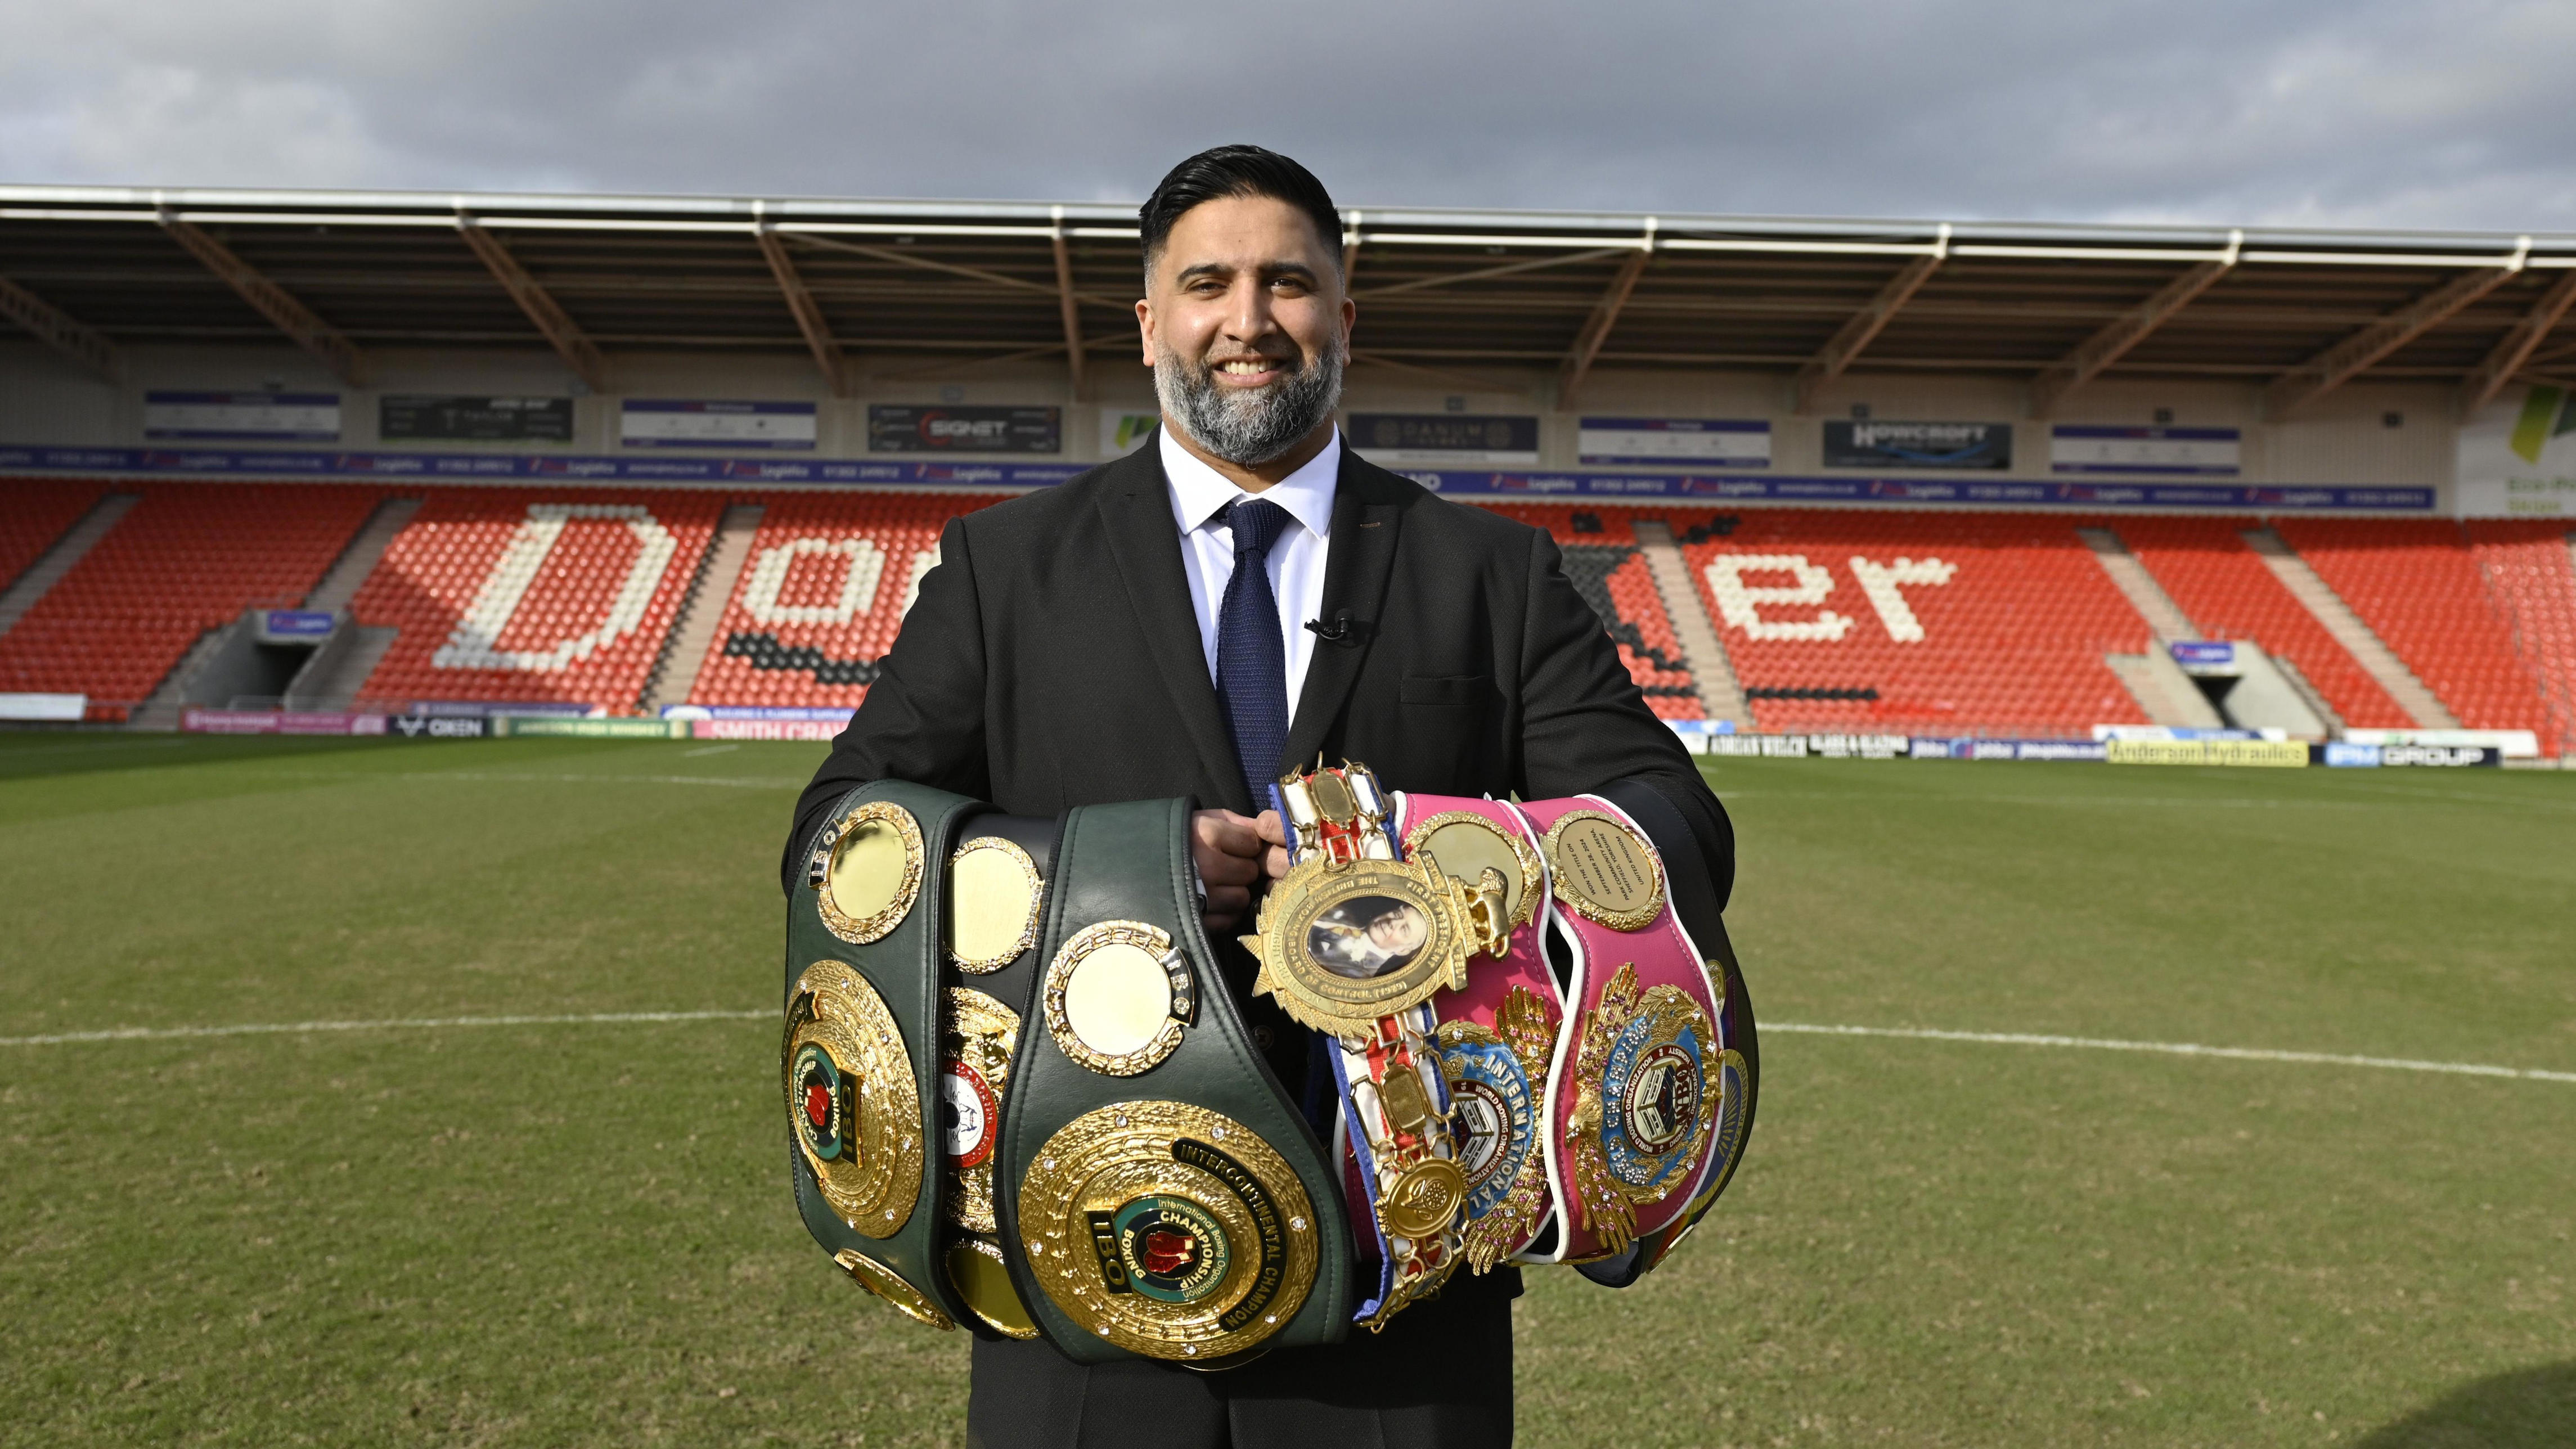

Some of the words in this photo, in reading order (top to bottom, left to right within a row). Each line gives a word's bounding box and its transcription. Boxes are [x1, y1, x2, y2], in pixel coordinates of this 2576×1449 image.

[929, 420, 1008, 436] SIGNET
[1853, 424, 1989, 448] HOWCROFT
[428, 719, 483, 737] OXEN
[712, 722, 781, 740] SMITH
[1859, 735, 1909, 753] GLAZING
[2112, 740, 2204, 759] Anderson
[2206, 740, 2304, 764] Hydraulics
[2384, 747, 2484, 766] GROUP
[811, 830, 836, 877] IBO
[1566, 843, 1574, 853] ON
[1579, 839, 1589, 852] 2024
[1590, 828, 1603, 849] ARENA,
[1599, 832, 1617, 863] YORKSHIRE
[1616, 836, 1633, 863] KINGDOM
[1422, 853, 1444, 890] BOXING
[1572, 853, 1581, 868] TITLE
[1579, 868, 1588, 880] THE
[1600, 849, 1621, 885] COMMUNITY
[1631, 864, 1644, 885] UNITED
[1358, 876, 1378, 886] THE
[1586, 880, 1596, 896] WON
[1592, 862, 1611, 895] SEPTEMBER
[1616, 863, 1633, 893] SHEFFIELD,
[1619, 886, 1629, 901] PARK
[1272, 899, 1301, 958] FLYWEIGHT
[1289, 902, 1315, 938] BOXING
[1406, 881, 1437, 903] FIRST
[1427, 906, 1447, 968] PRESIDENT
[1288, 941, 1306, 974] BOARD
[1167, 958, 1190, 1015] IBO
[1276, 962, 1321, 1005] CHAMPION
[1305, 975, 1320, 985] OF
[1320, 985, 1372, 998] CONTROL
[1374, 980, 1408, 998] (1929)
[794, 1047, 817, 1073] Organization
[1668, 1046, 1691, 1065] HONESTY
[1606, 1019, 1649, 1128] CHAMPION
[1625, 1055, 1654, 1112] ORGANIZATION
[798, 1060, 817, 1141] CHAMPIONSHIP
[1475, 1084, 1499, 1105] WORLD
[1675, 1062, 1692, 1127] WBO
[1690, 1068, 1700, 1115] DEMOCRACY
[829, 1085, 840, 1139] BOXING
[842, 1084, 853, 1153] IBO
[1495, 1104, 1509, 1134] BOXING
[1625, 1111, 1640, 1142] BOXING
[1470, 1054, 1528, 1209] INTERNATIONAL
[1638, 1138, 1654, 1154] WORLD
[1669, 1123, 1689, 1149] DIGNITY
[1468, 1135, 1508, 1185] ORGANIZATION
[1158, 1199, 1215, 1230] International
[1181, 1144, 1281, 1261] INTERCONTINENTAL
[1093, 1221, 1125, 1286] IBO
[1122, 1228, 1147, 1279] BOXING
[1160, 1210, 1213, 1289] CHAMPIONSHIP
[1211, 1229, 1226, 1258] Boxing
[1183, 1259, 1226, 1299] Organization
[1225, 1267, 1278, 1328] CHAMPION
